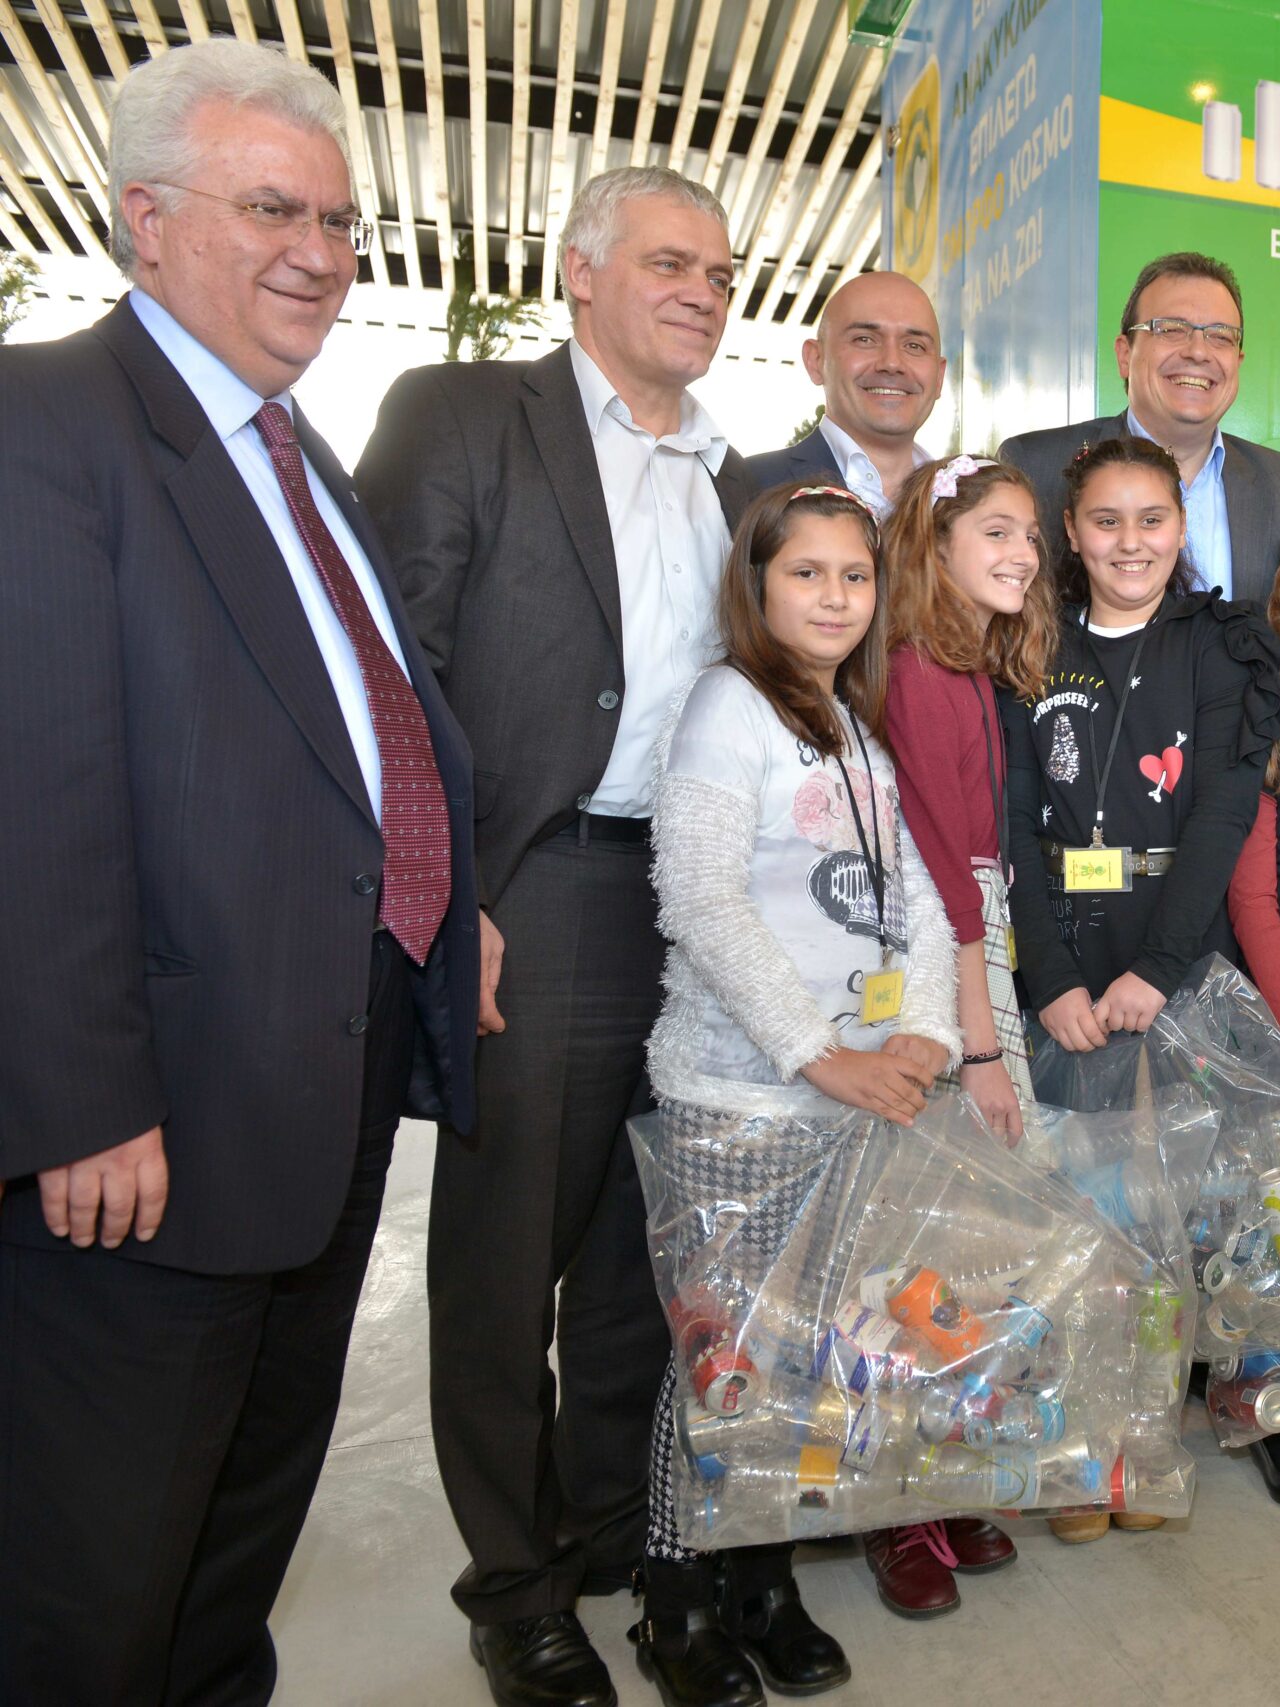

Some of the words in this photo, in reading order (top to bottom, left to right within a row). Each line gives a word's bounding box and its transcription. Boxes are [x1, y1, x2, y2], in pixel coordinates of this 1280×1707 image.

[969, 53, 1037, 177] ΕΠΙΛΕΓΩ
[1010, 94, 1073, 207] ΚΟΣΜΟ
[987, 243, 1011, 304] ΝΑ
[1015, 207, 1043, 280] ΖΩ!
